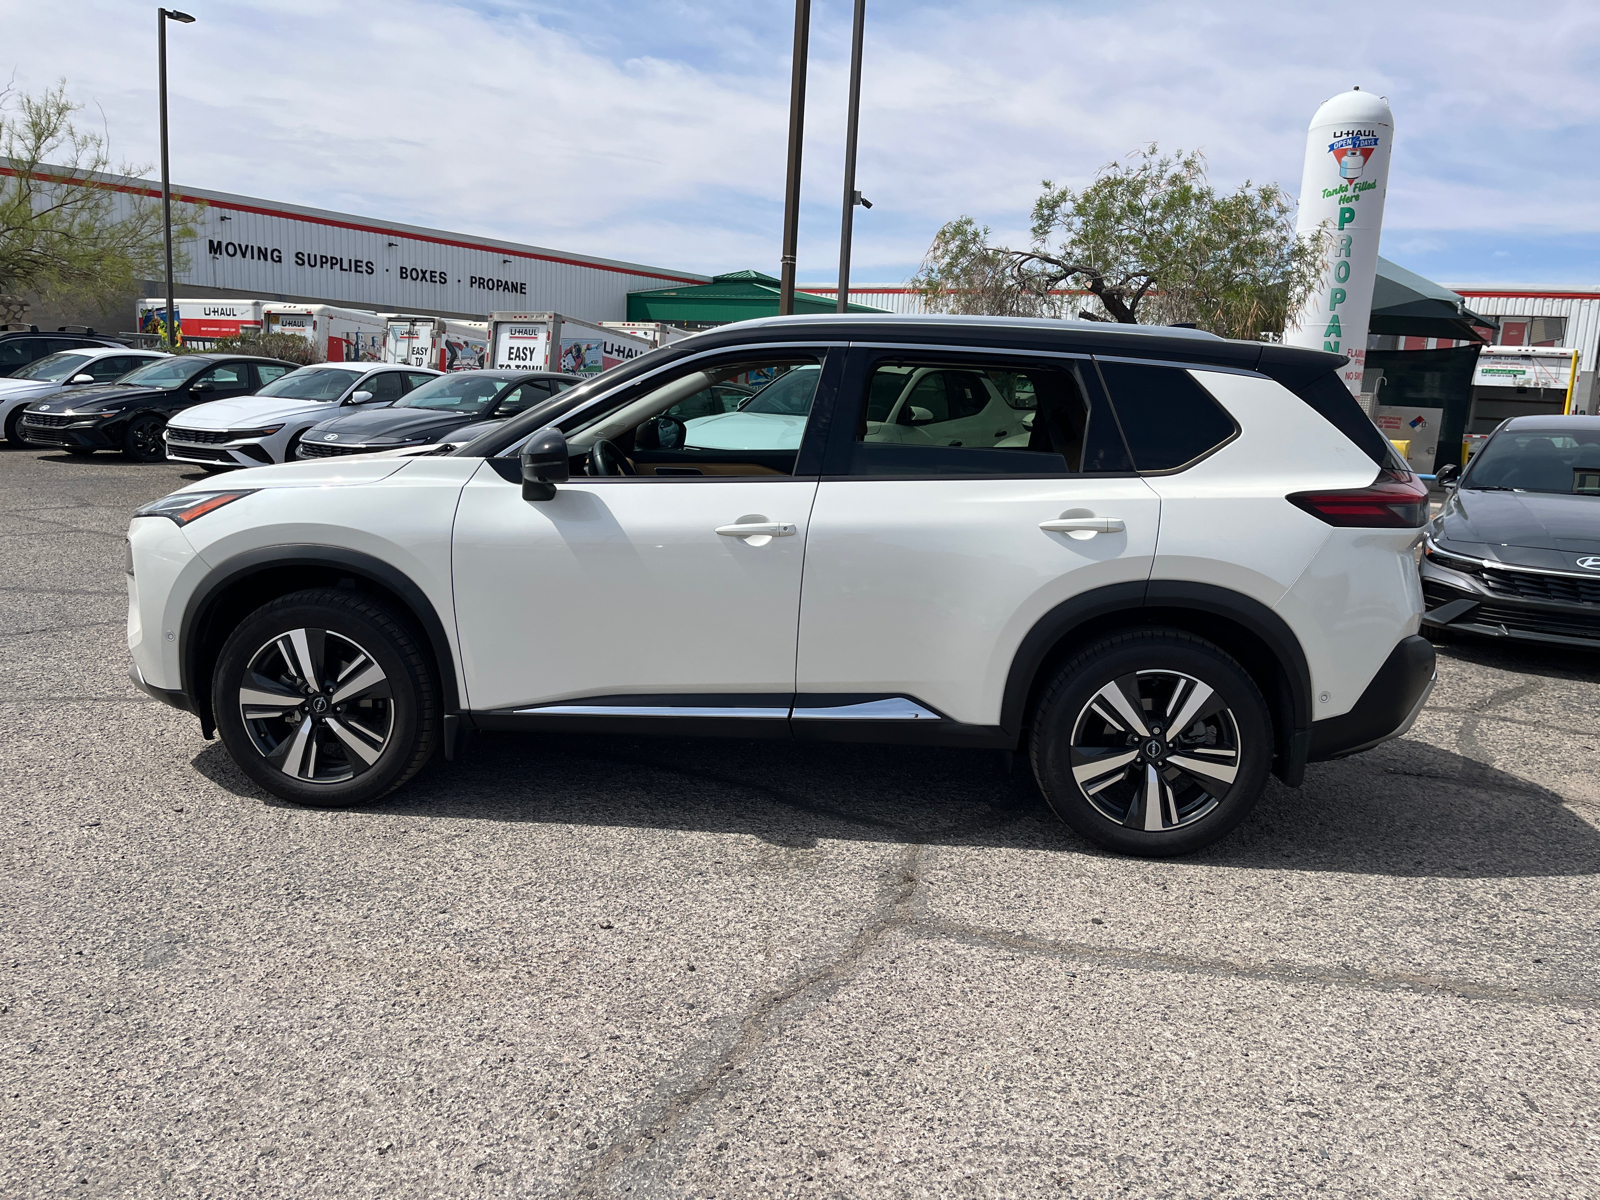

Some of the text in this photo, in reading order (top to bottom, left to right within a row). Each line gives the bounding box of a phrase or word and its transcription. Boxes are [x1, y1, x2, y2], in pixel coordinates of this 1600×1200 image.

[1333, 130, 1377, 138] U-HAUL
[1333, 139, 1352, 149] OPEN
[1360, 139, 1375, 147] DAYS
[1322, 179, 1377, 199] Tanks Filled
[1338, 194, 1360, 205] Here
[208, 239, 527, 295] MOVING SUPPLIES BOXES PROPANE
[203, 307, 237, 316] U-HAUL
[281, 320, 306, 328] U-HAUL
[412, 347, 429, 355] EASY
[507, 346, 536, 362] EASY
[1345, 372, 1354, 380] NO
